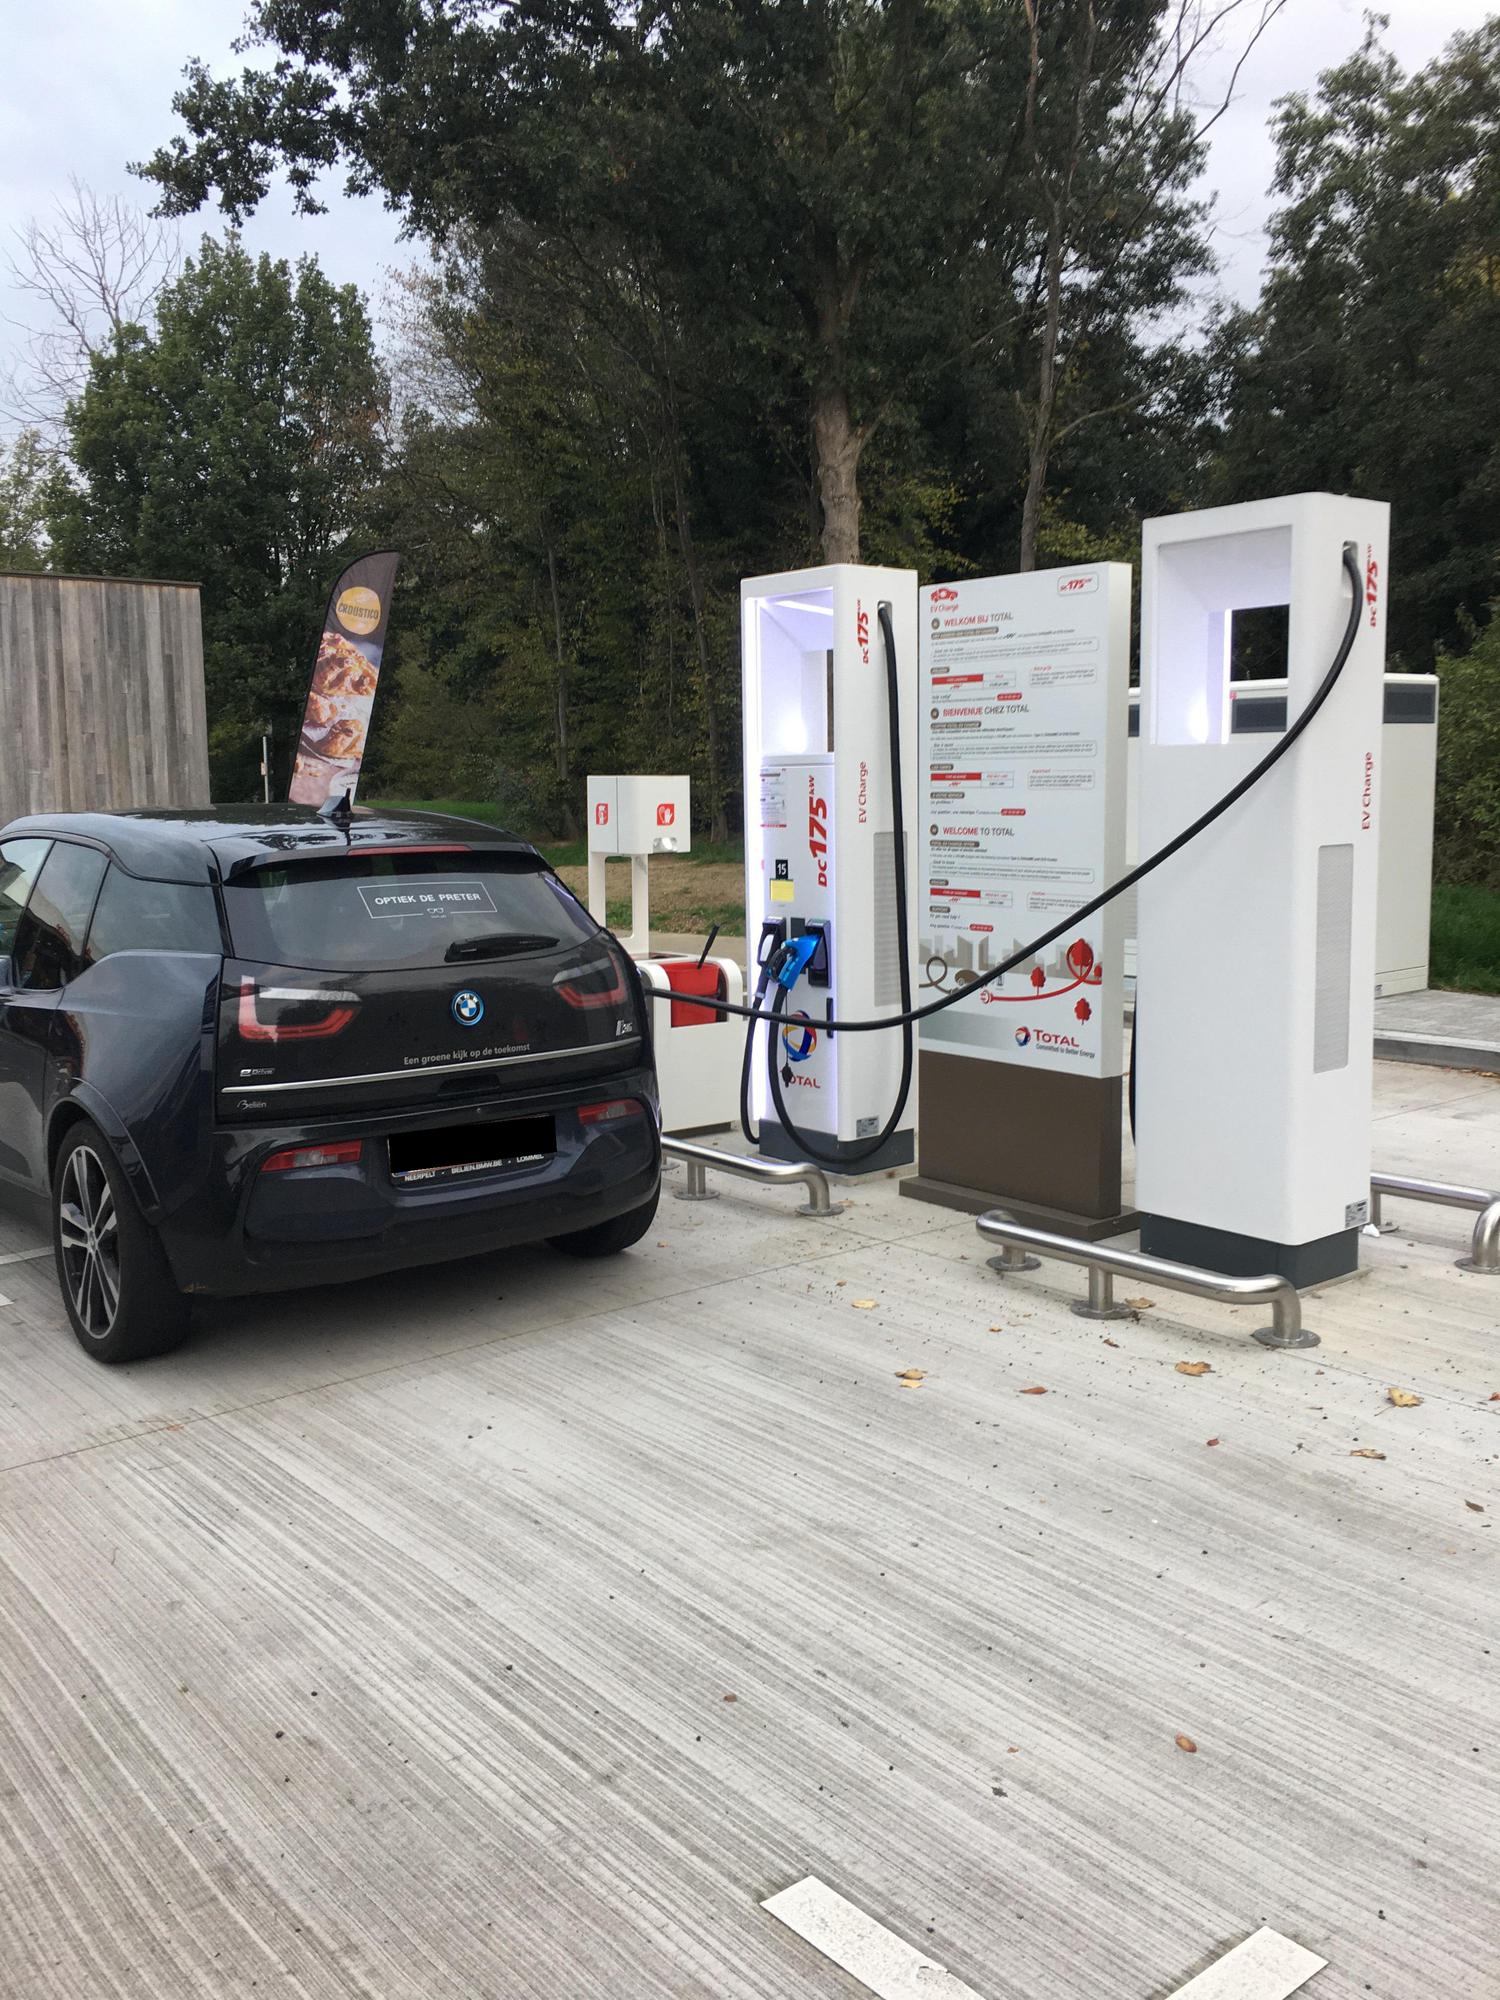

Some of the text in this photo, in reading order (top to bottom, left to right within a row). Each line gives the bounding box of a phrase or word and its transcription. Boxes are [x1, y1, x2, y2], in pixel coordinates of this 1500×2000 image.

[943, 611, 1014, 627] WELKOM BIJ TOTAL
[943, 703, 1030, 717] BIENVENUE CHEZ TOTAL
[859, 761, 868, 823] EV Charge
[1362, 752, 1373, 829] EV Charge
[943, 826, 1015, 837] WELCOME TO TOTAL
[777, 864, 787, 875] 15
[374, 893, 481, 905] OPTIEK DE PRETER
[1033, 1029, 1080, 1047] TOTAL
[404, 1043, 530, 1065] Een groene kijk op de toekomst
[780, 1070, 821, 1089] OTAL
